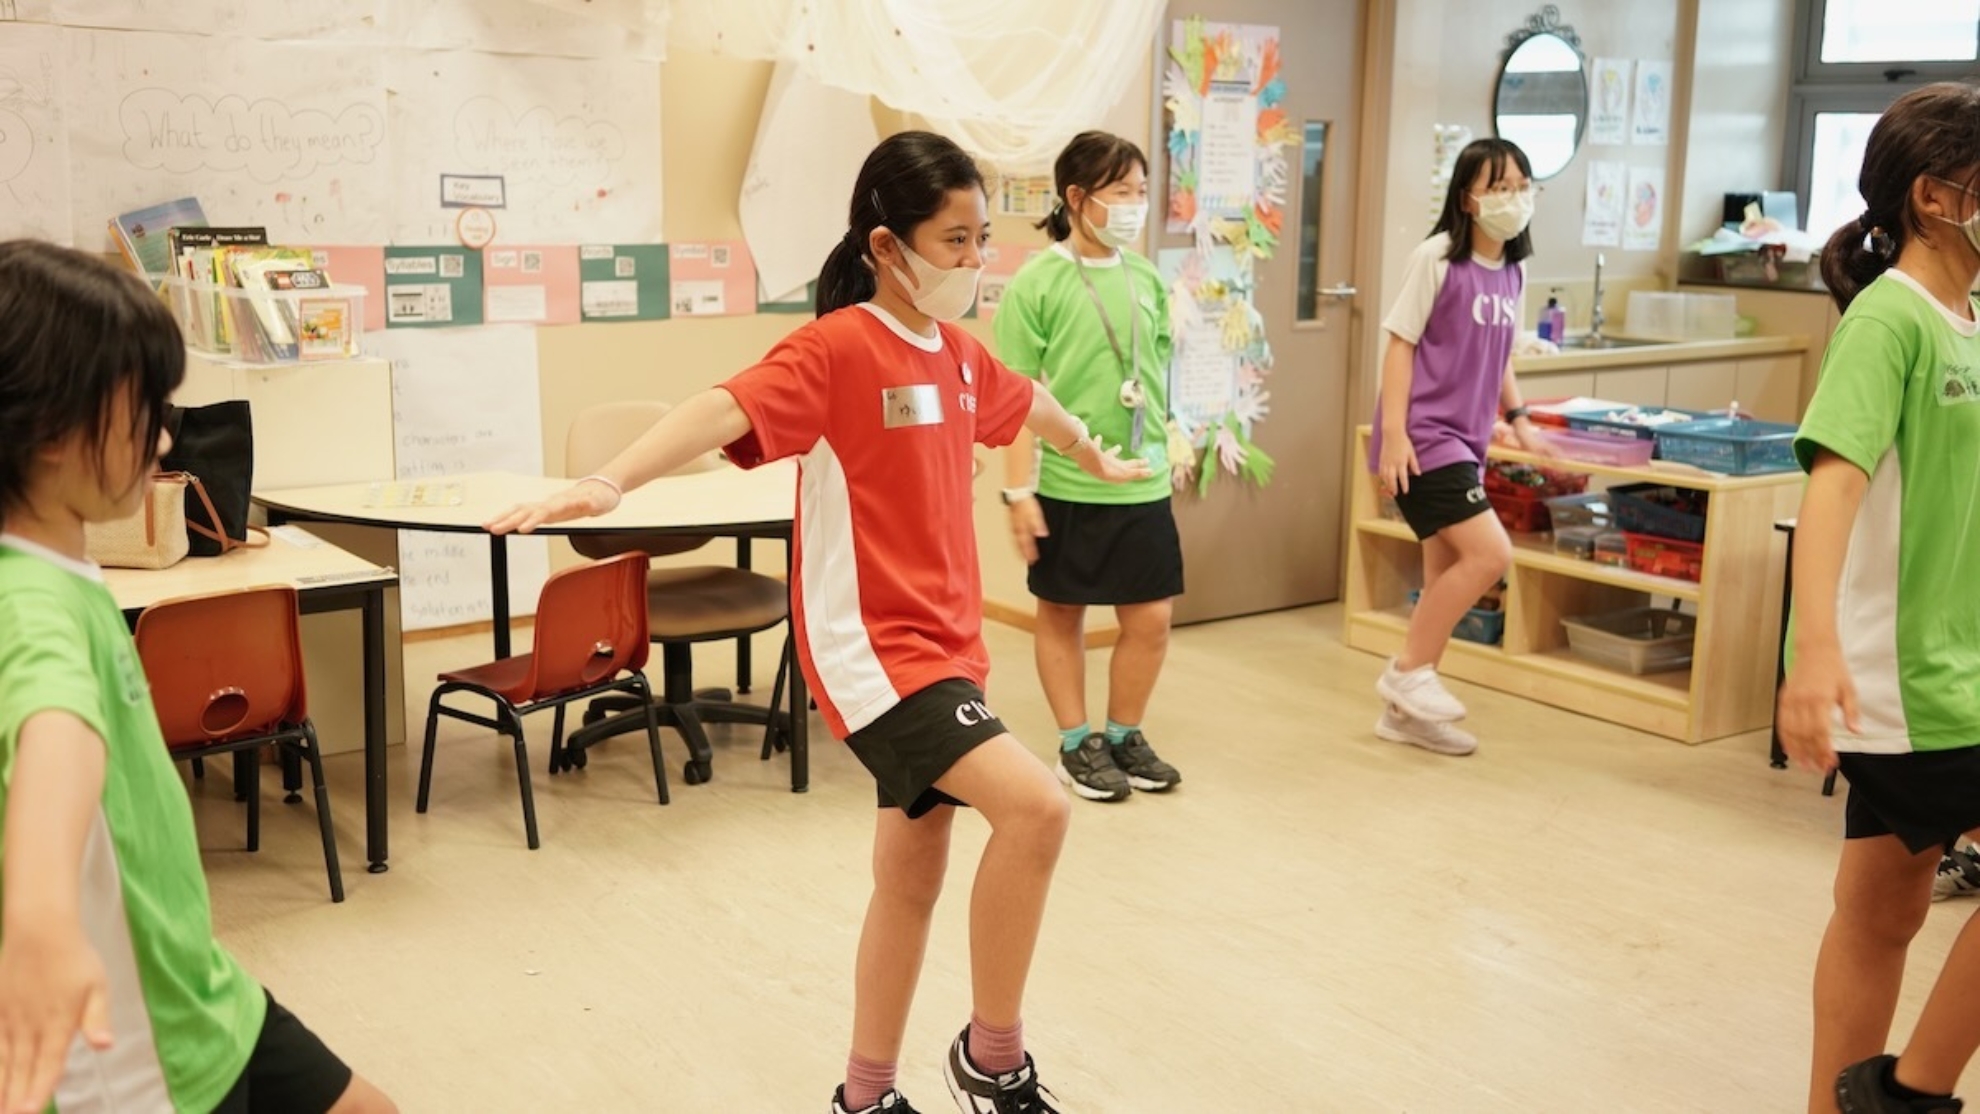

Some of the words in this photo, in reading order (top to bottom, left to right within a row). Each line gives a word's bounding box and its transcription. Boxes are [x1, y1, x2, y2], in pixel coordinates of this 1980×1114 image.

[142, 108, 208, 150] What
[224, 112, 252, 153] do
[260, 112, 301, 170] they
[468, 117, 528, 153] Where
[1472, 292, 1515, 326] CIS
